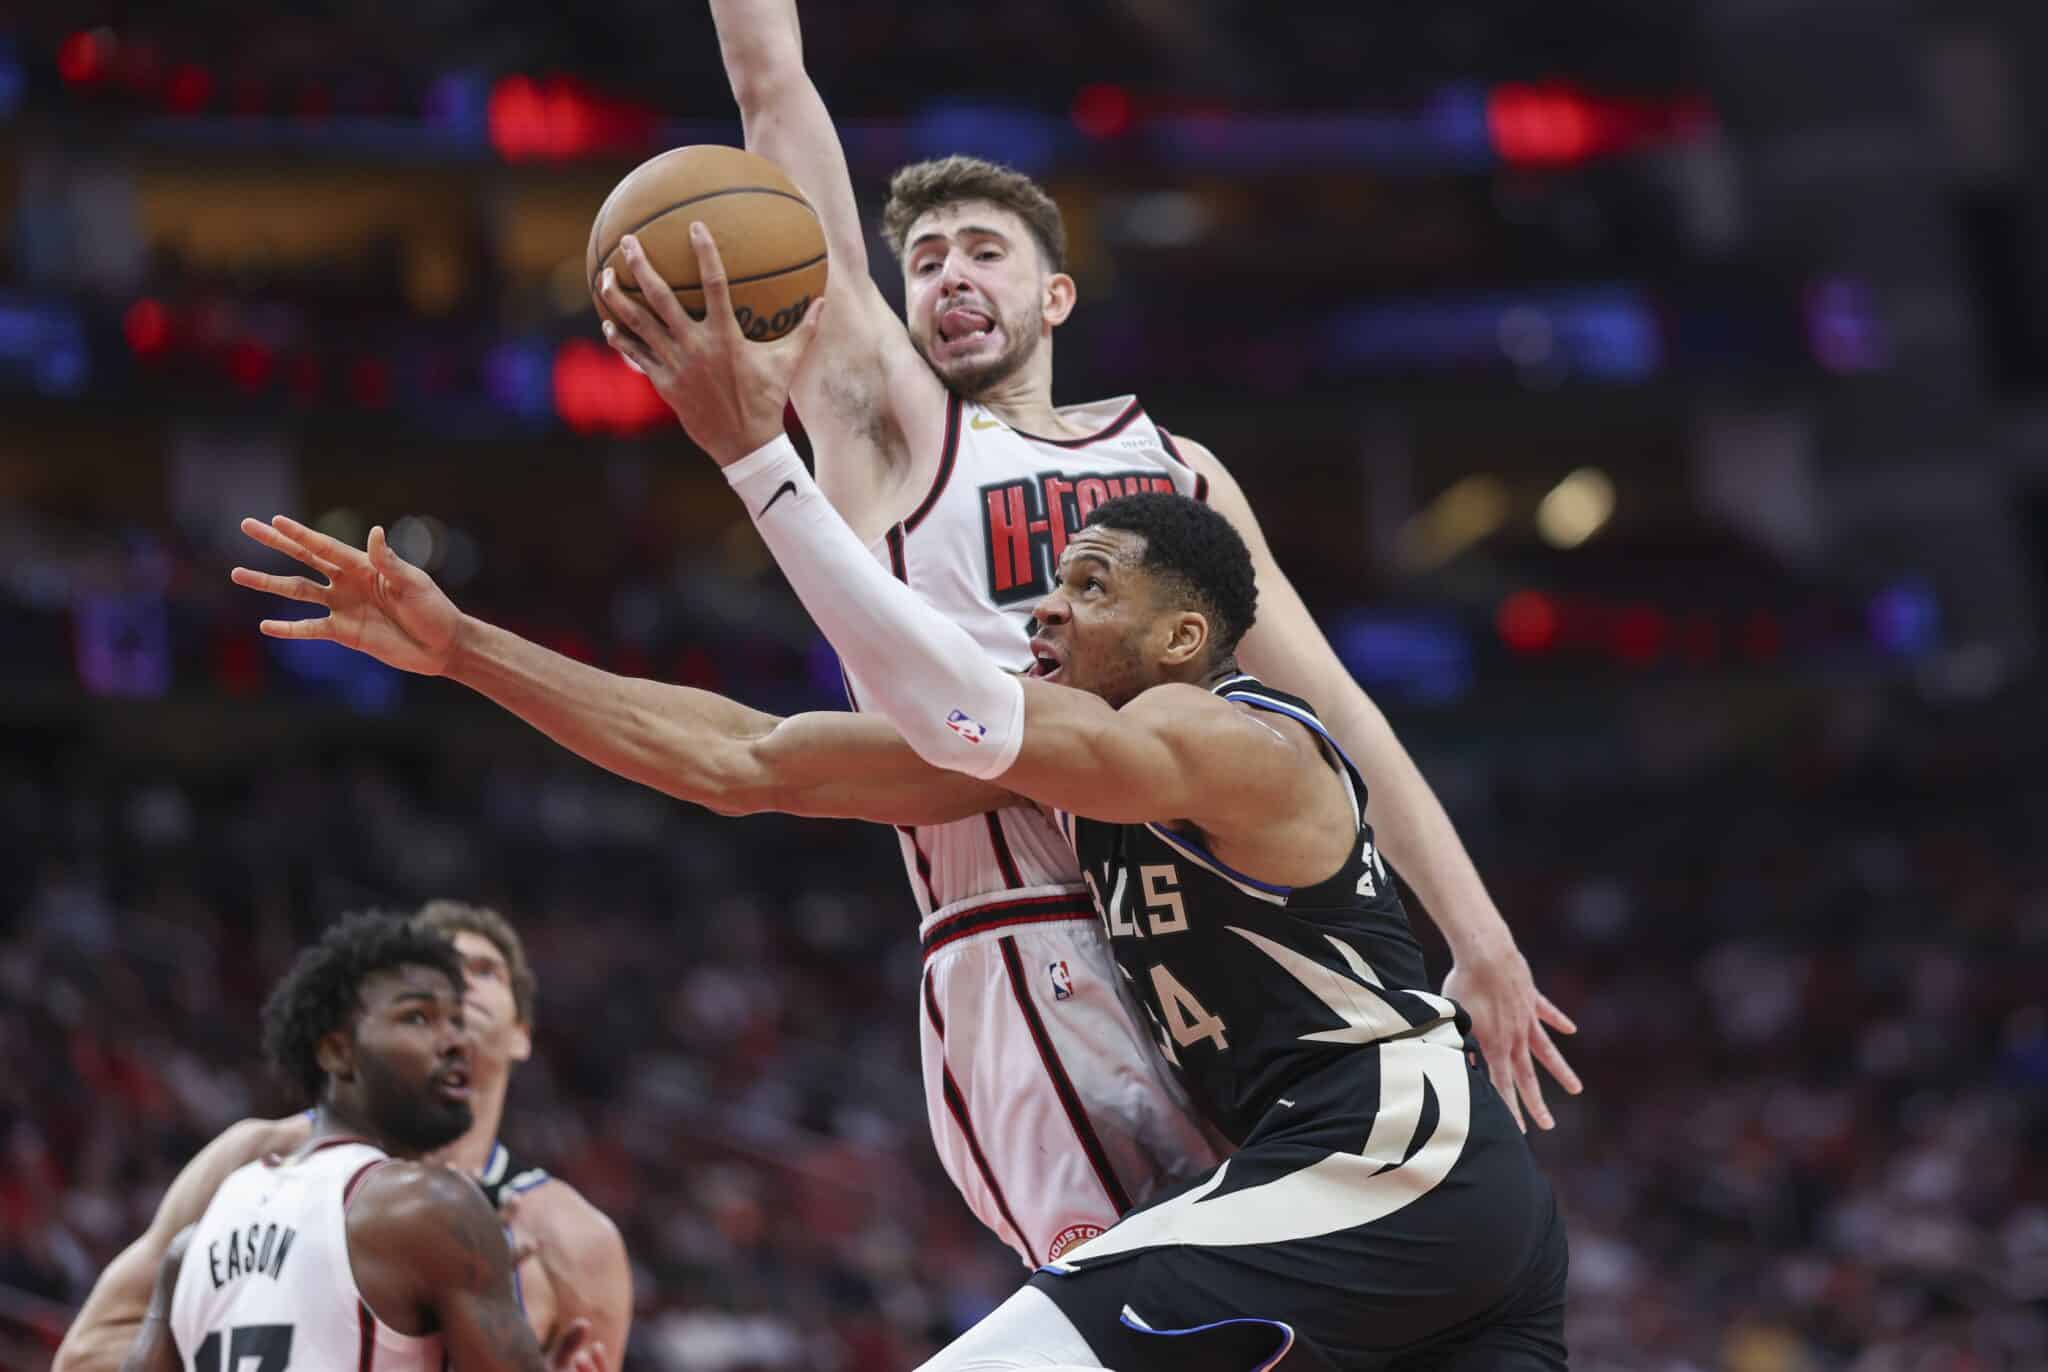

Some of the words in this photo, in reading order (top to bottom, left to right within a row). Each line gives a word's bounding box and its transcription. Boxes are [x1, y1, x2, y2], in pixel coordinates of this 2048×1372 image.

[733, 293, 810, 337] lson
[979, 470, 1176, 606] H-T
[209, 1223, 296, 1289] EASON
[1049, 1227, 1106, 1261] OUSTO
